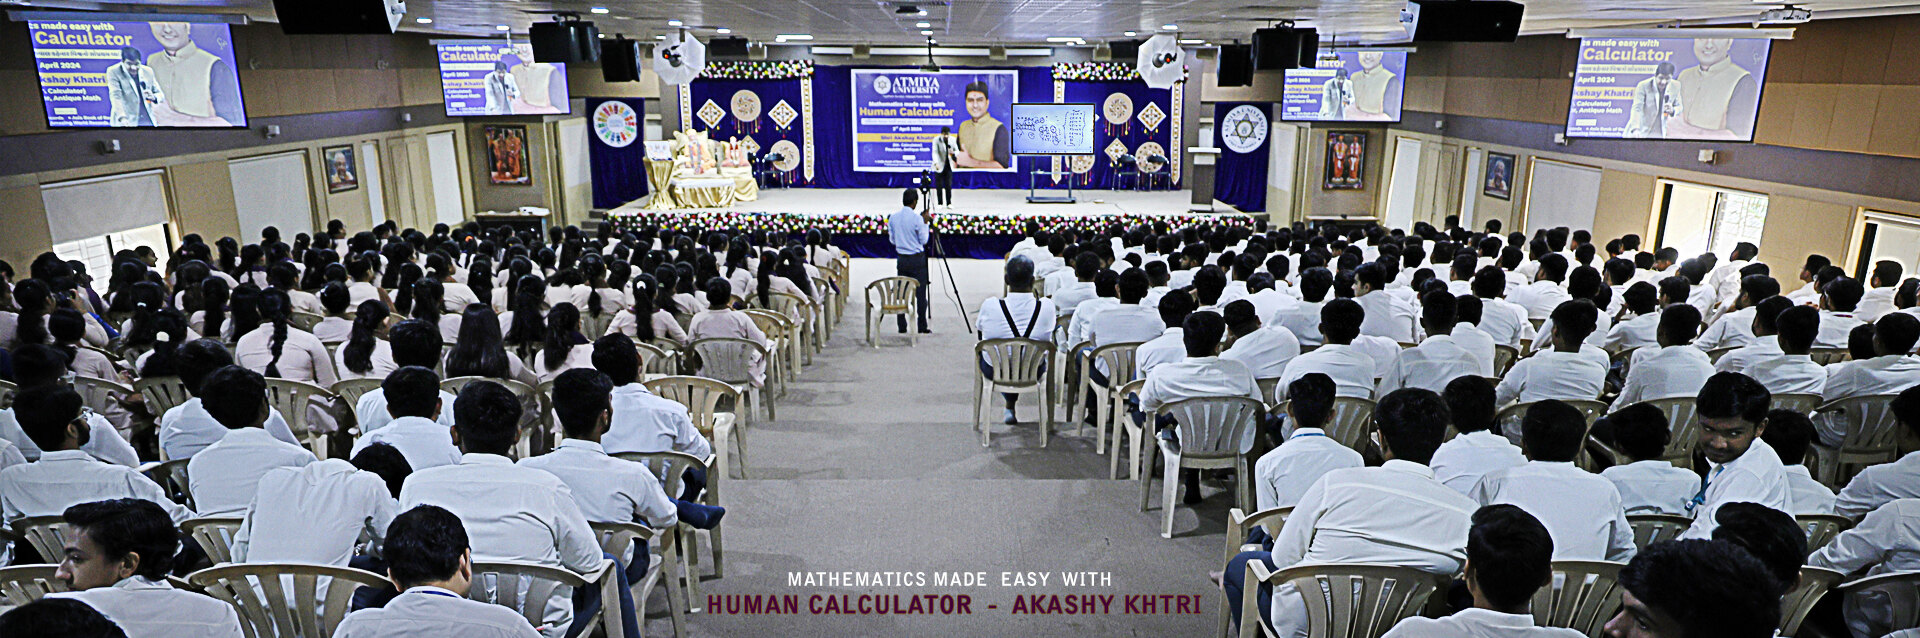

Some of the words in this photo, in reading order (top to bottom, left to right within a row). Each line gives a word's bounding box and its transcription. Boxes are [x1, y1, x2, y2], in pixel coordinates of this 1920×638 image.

[41, 21, 68, 30] made
[69, 22, 91, 32] easy
[91, 22, 115, 31] with
[35, 30, 133, 46] Calculator
[1592, 38, 1617, 47] made
[1618, 39, 1639, 48] easy
[1639, 39, 1660, 47] with
[441, 51, 502, 62] Calculator
[1583, 47, 1674, 61] Calculator
[40, 61, 60, 70] April
[60, 61, 82, 69] 2024
[73, 75, 107, 83] Khatri
[892, 76, 940, 88] ATMIYA
[1577, 76, 1596, 84] April
[1596, 76, 1616, 84] 2024
[892, 86, 940, 94] UNIVERSITY
[1604, 89, 1634, 97] Khatri
[859, 106, 897, 116] Human
[899, 107, 955, 117] Calculator
